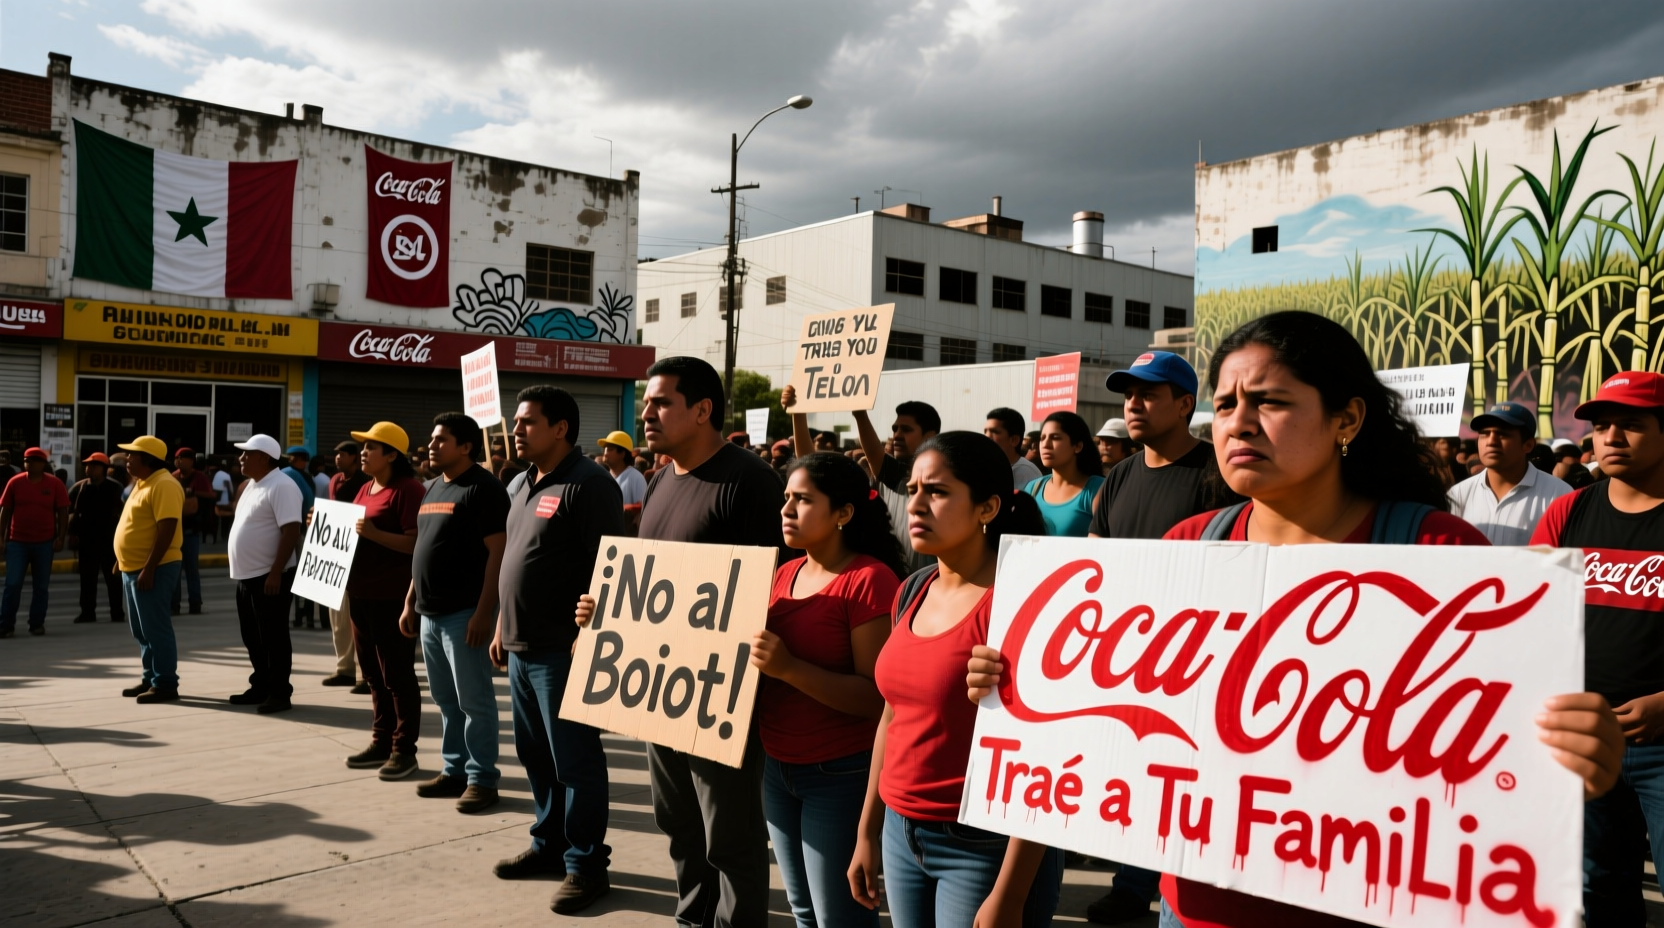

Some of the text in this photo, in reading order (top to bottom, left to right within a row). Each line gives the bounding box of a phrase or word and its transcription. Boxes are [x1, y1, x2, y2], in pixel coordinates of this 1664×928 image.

[688, 558, 742, 633] al
[582, 630, 751, 740] Boiot!
[998, 558, 1550, 782] Coca-Cola
[979, 735, 1084, 815] Traé
[1099, 778, 1132, 828] a
[1147, 763, 1213, 845] Tu
